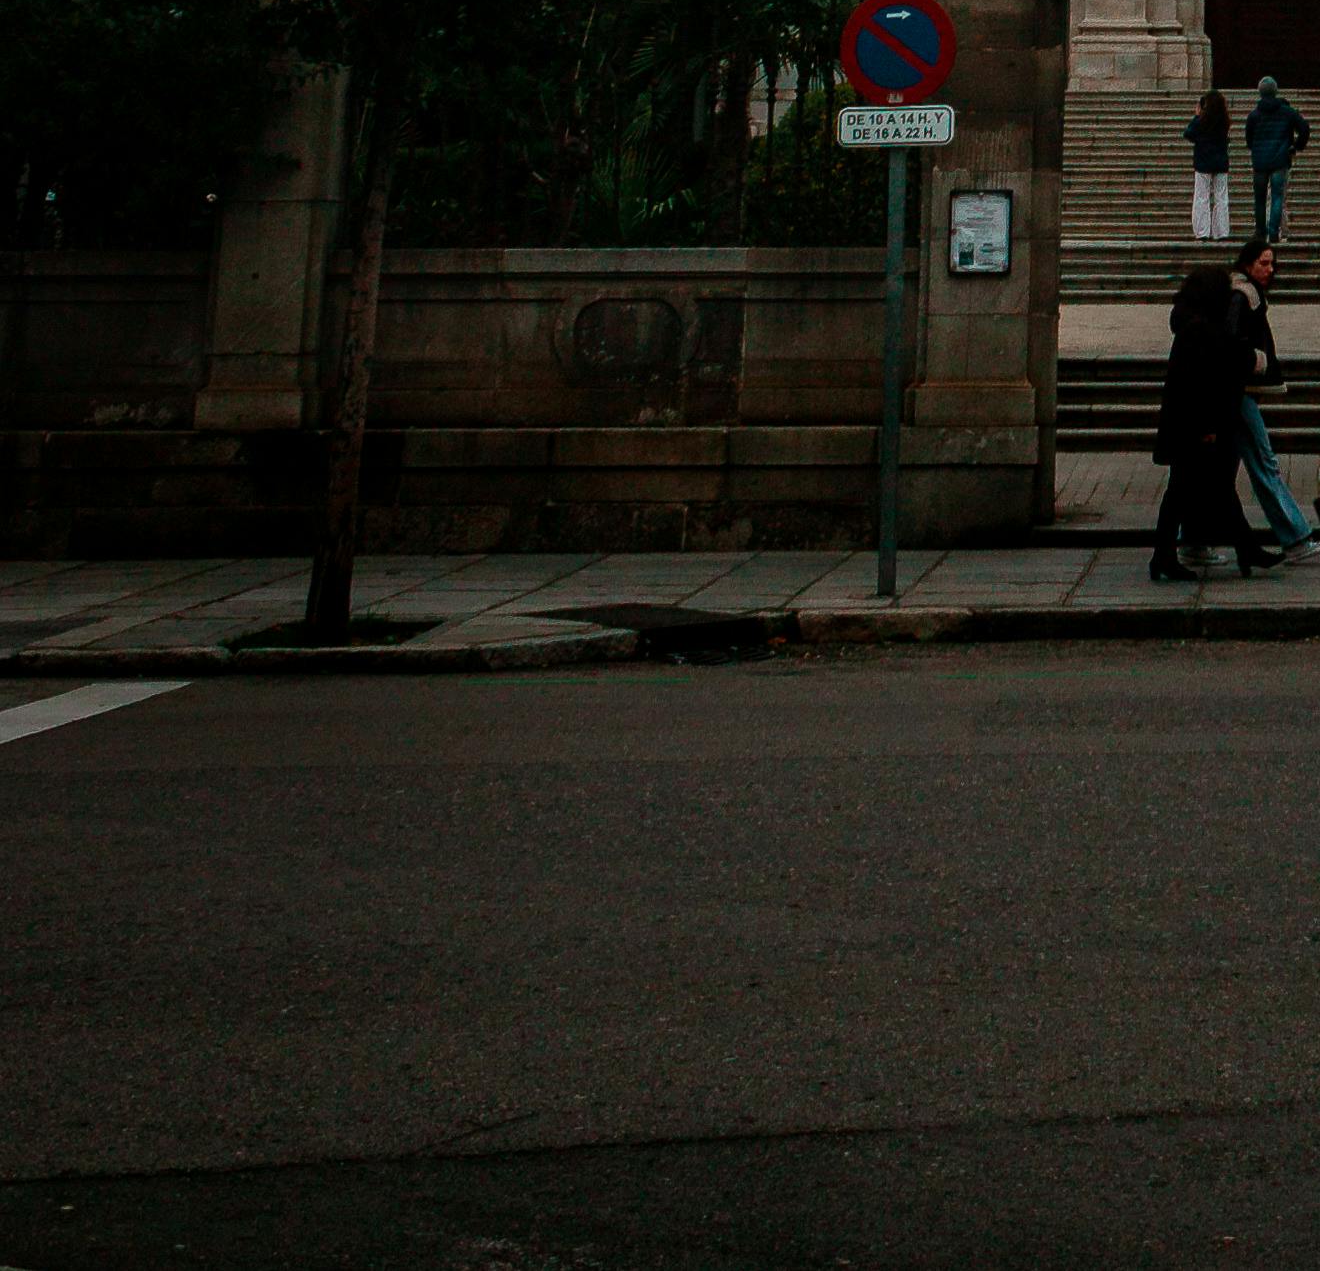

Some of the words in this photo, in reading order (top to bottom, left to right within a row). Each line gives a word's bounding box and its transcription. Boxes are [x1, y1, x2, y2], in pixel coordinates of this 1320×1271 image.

[847, 114, 865, 126] DE
[869, 114, 883, 126] 10
[887, 114, 896, 125] A
[900, 113, 914, 124] 14
[934, 112, 943, 123] Y
[852, 128, 871, 140] DE
[874, 128, 889, 139] 16
[891, 128, 902, 139] A
[905, 128, 920, 138] 22
